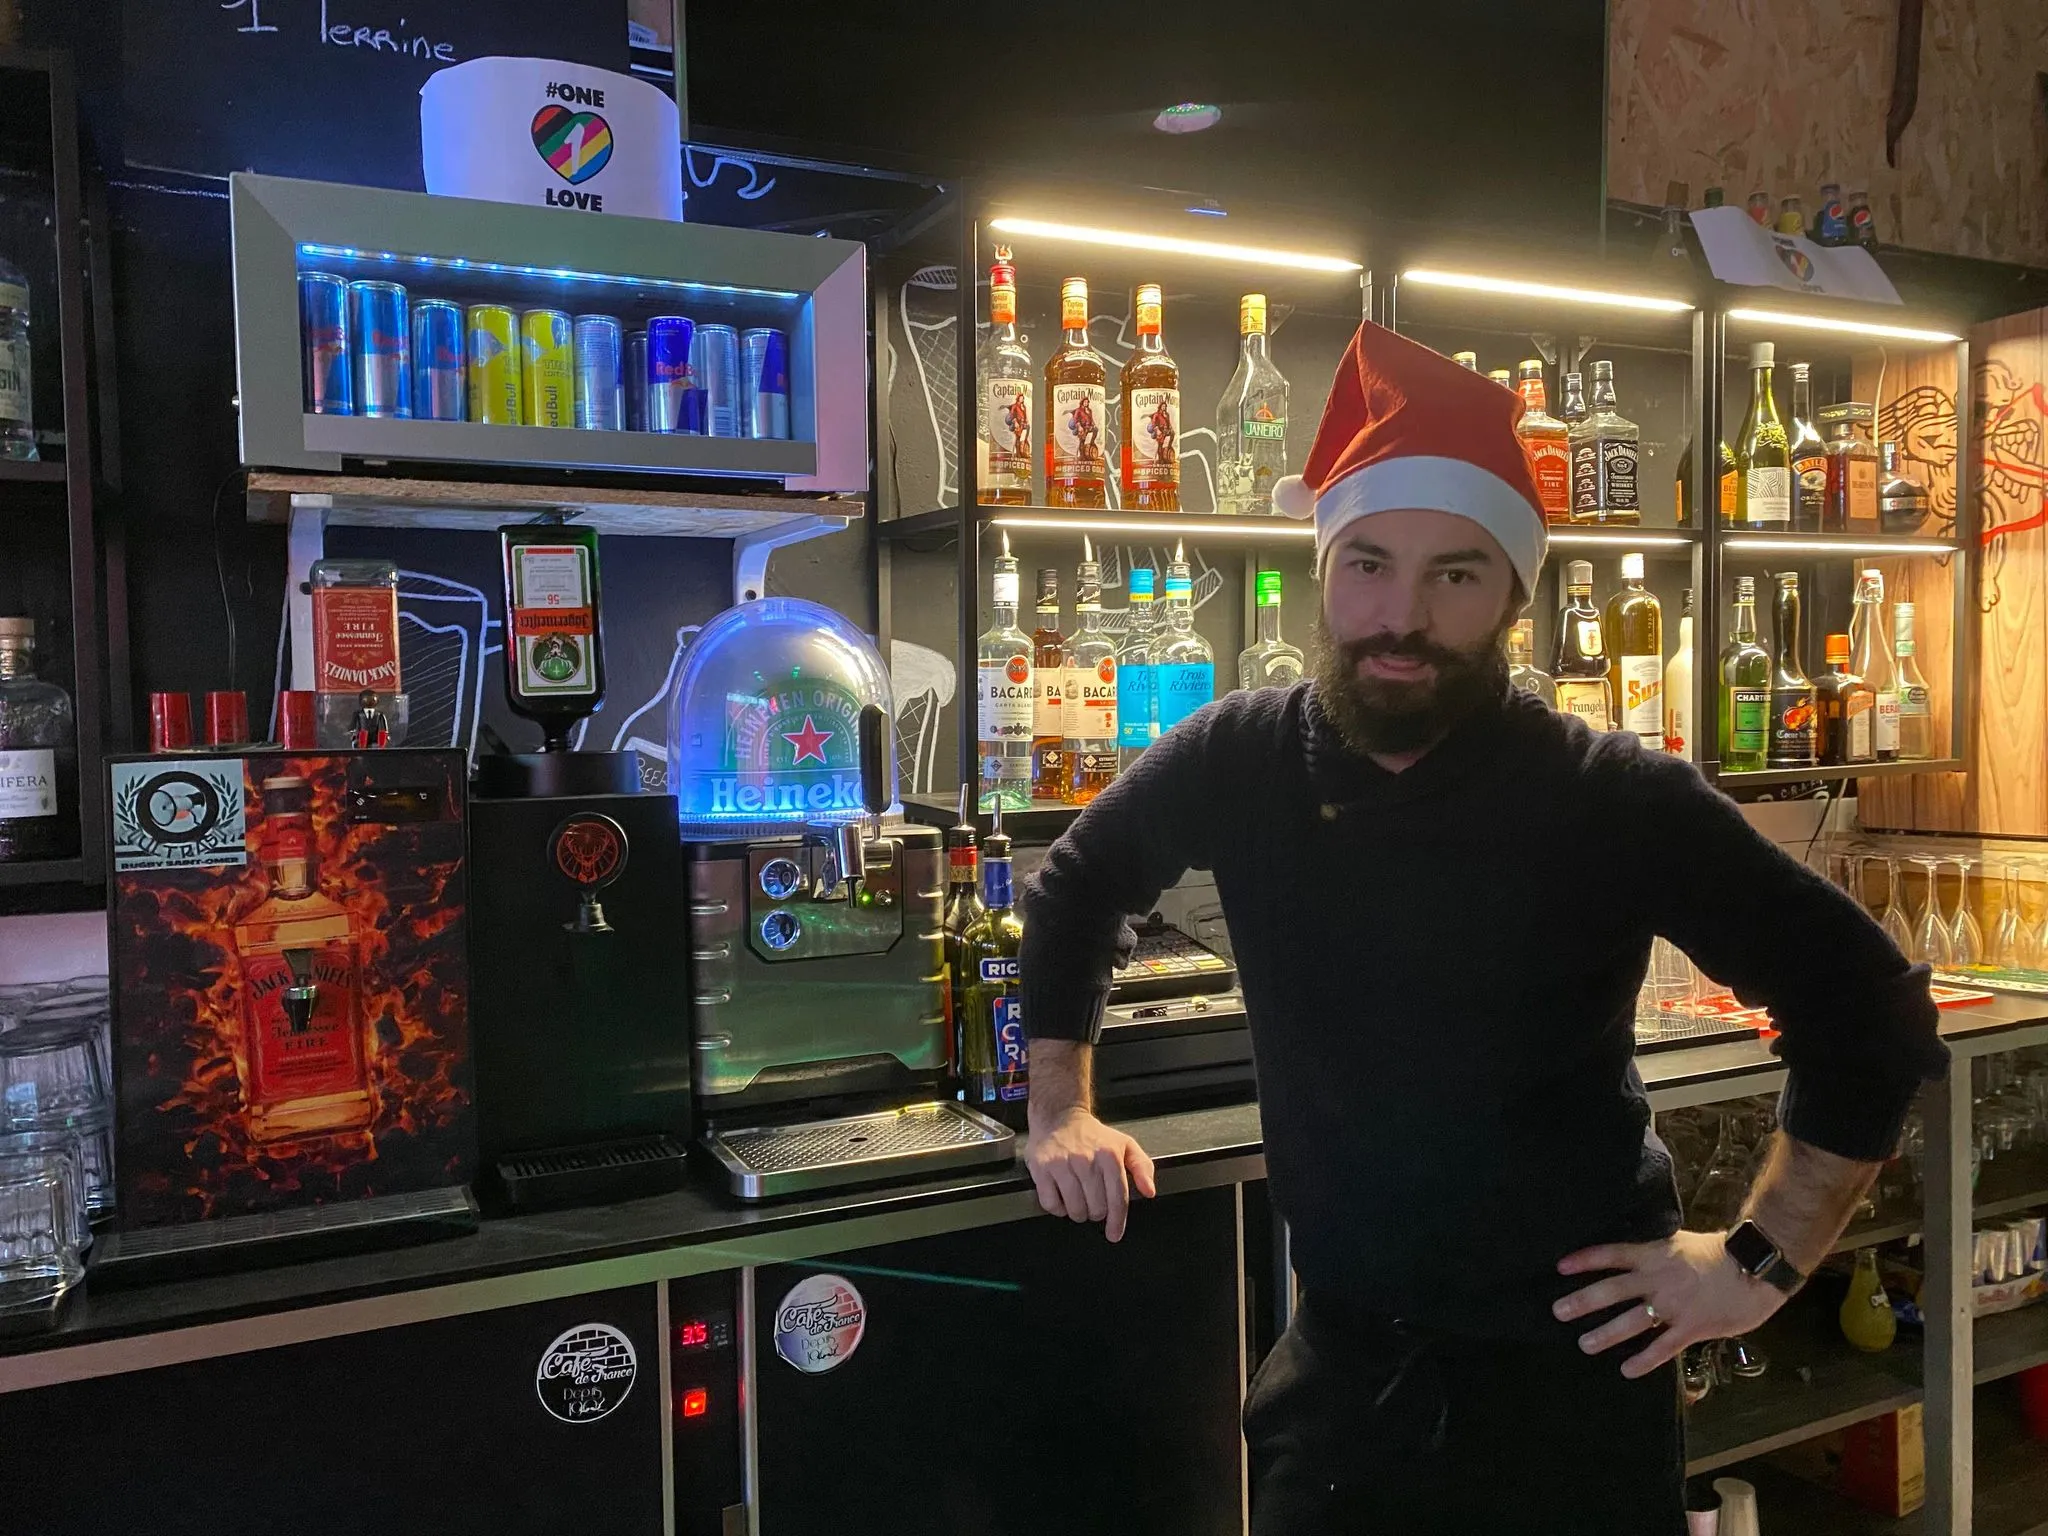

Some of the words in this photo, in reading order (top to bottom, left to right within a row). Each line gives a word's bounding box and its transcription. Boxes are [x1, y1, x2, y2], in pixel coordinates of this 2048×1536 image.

[545, 81, 605, 108] #ONE
[545, 187, 603, 213] LOVE
[1057, 387, 1086, 403] Captain
[1086, 387, 1105, 403] Morg
[1135, 391, 1163, 407] Captain
[1245, 423, 1284, 439] JANEIRO
[1605, 447, 1618, 462] JACK
[547, 593, 560, 605] 56
[343, 622, 375, 631] FIRE
[368, 660, 397, 682] JACK
[990, 686, 1033, 699] BACAR
[1628, 680, 1661, 711] SUZ
[710, 774, 864, 812] Heinek
[139, 833, 219, 859] ULTRAS
[121, 860, 163, 870] RUGBY
[165, 857, 239, 867] SAINT-OMER
[252, 968, 290, 1000] JACK
[780, 1303, 824, 1333] Café
[810, 1322, 823, 1335] de
[823, 1312, 861, 1332] France
[543, 1351, 594, 1380] Café
[574, 1372, 589, 1385] de
[590, 1363, 633, 1383] France
